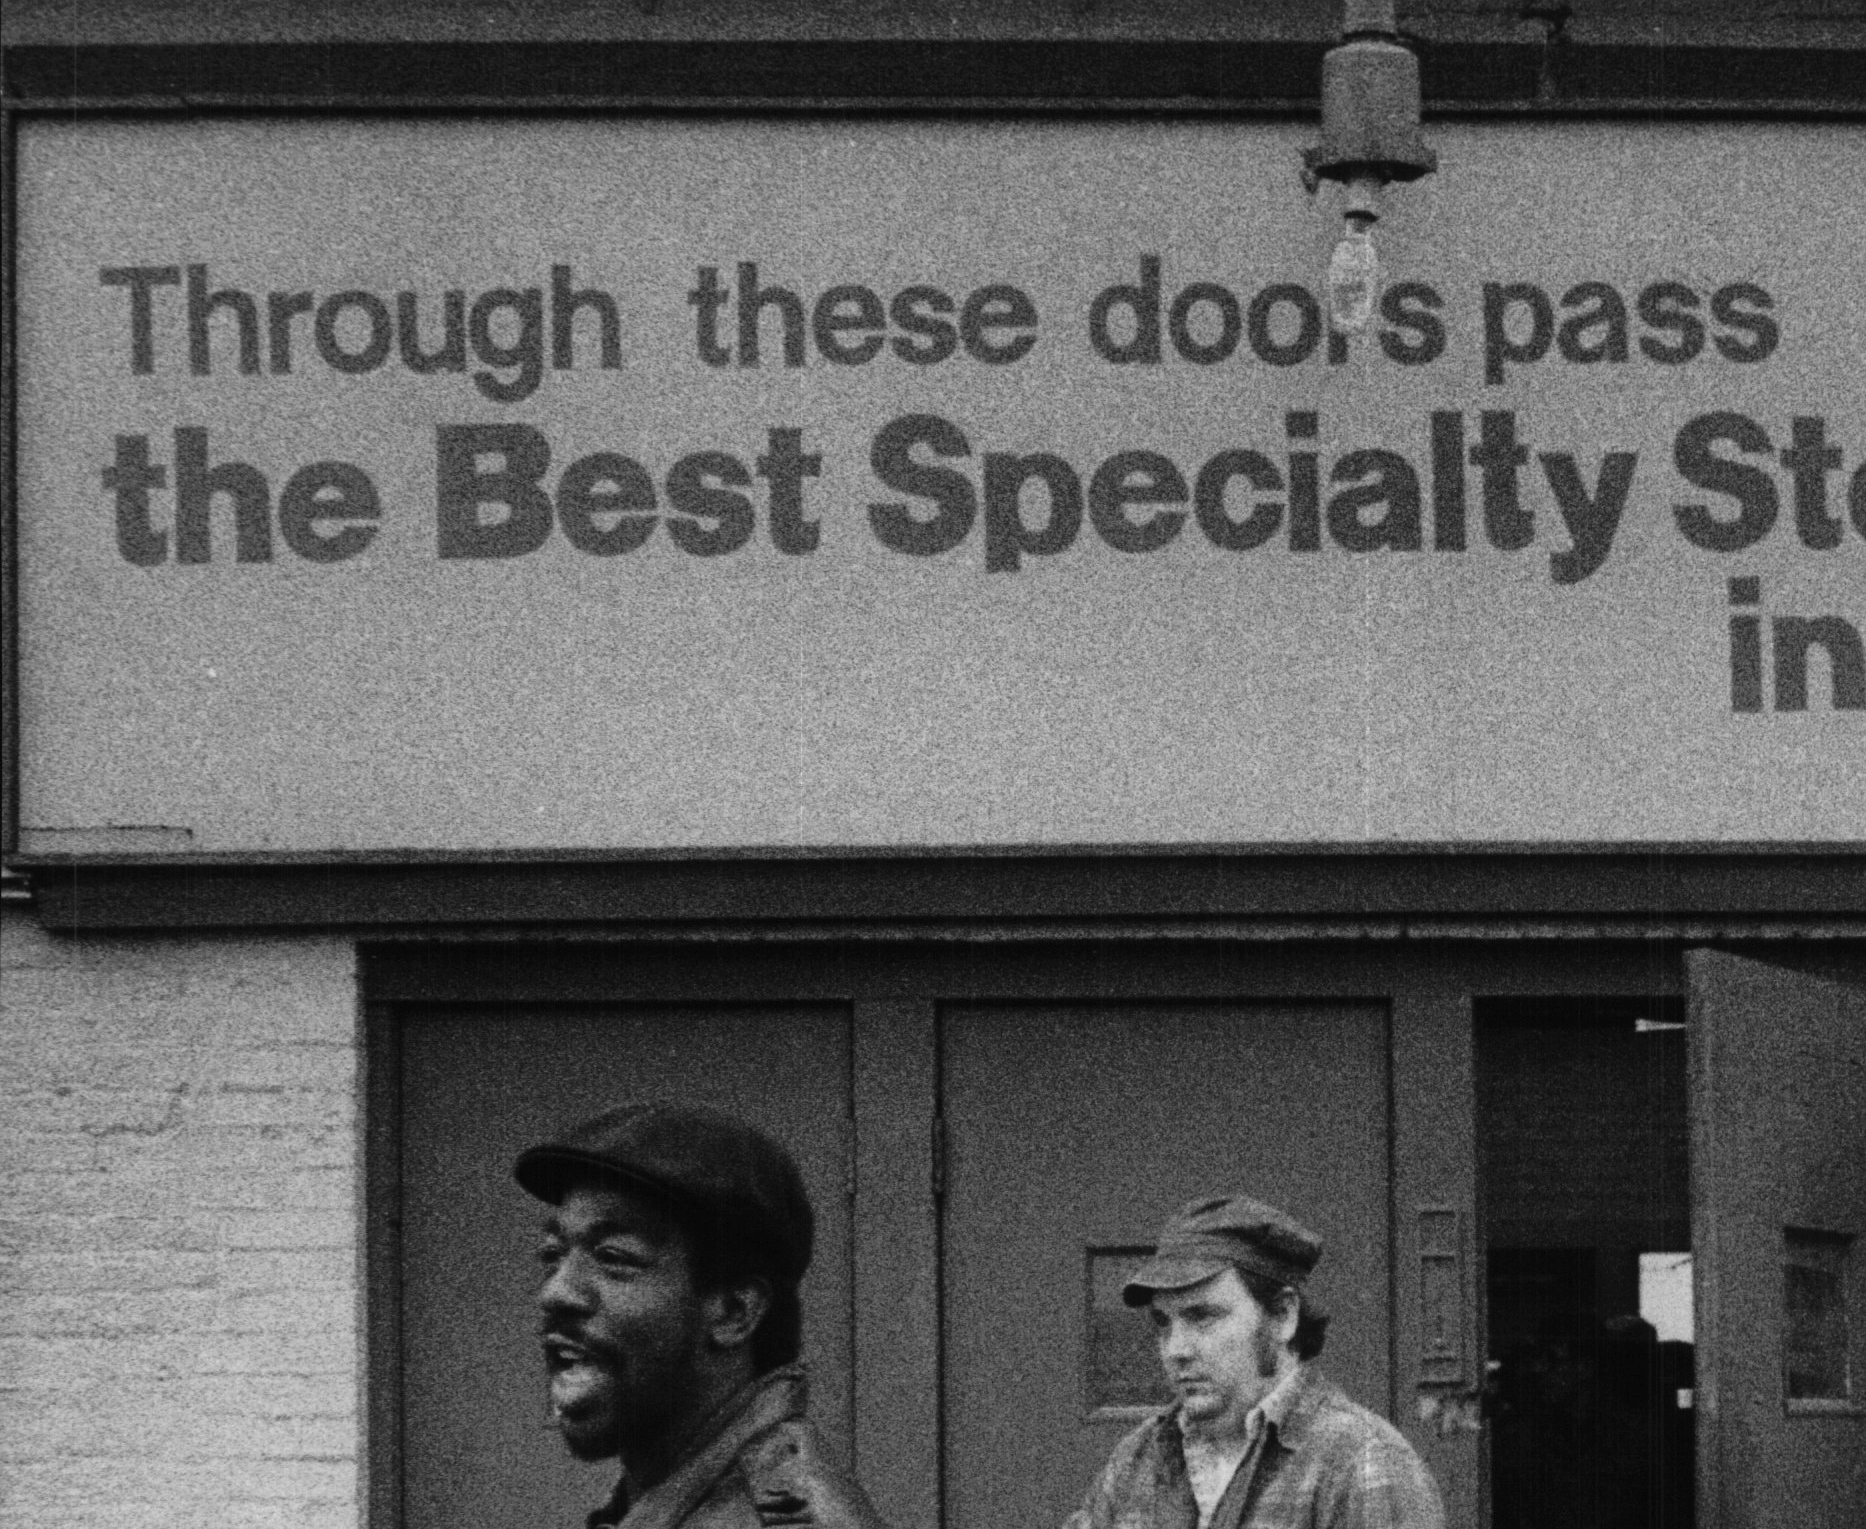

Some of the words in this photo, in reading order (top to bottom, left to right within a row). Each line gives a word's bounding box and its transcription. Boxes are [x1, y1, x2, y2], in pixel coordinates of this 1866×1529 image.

[101, 263, 622, 404] Through
[688, 261, 1038, 367] these
[1482, 281, 1779, 386] pass
[102, 426, 382, 566] the
[436, 423, 821, 559] Best
[869, 409, 1637, 584] Specialty
[1728, 576, 1866, 712] in
